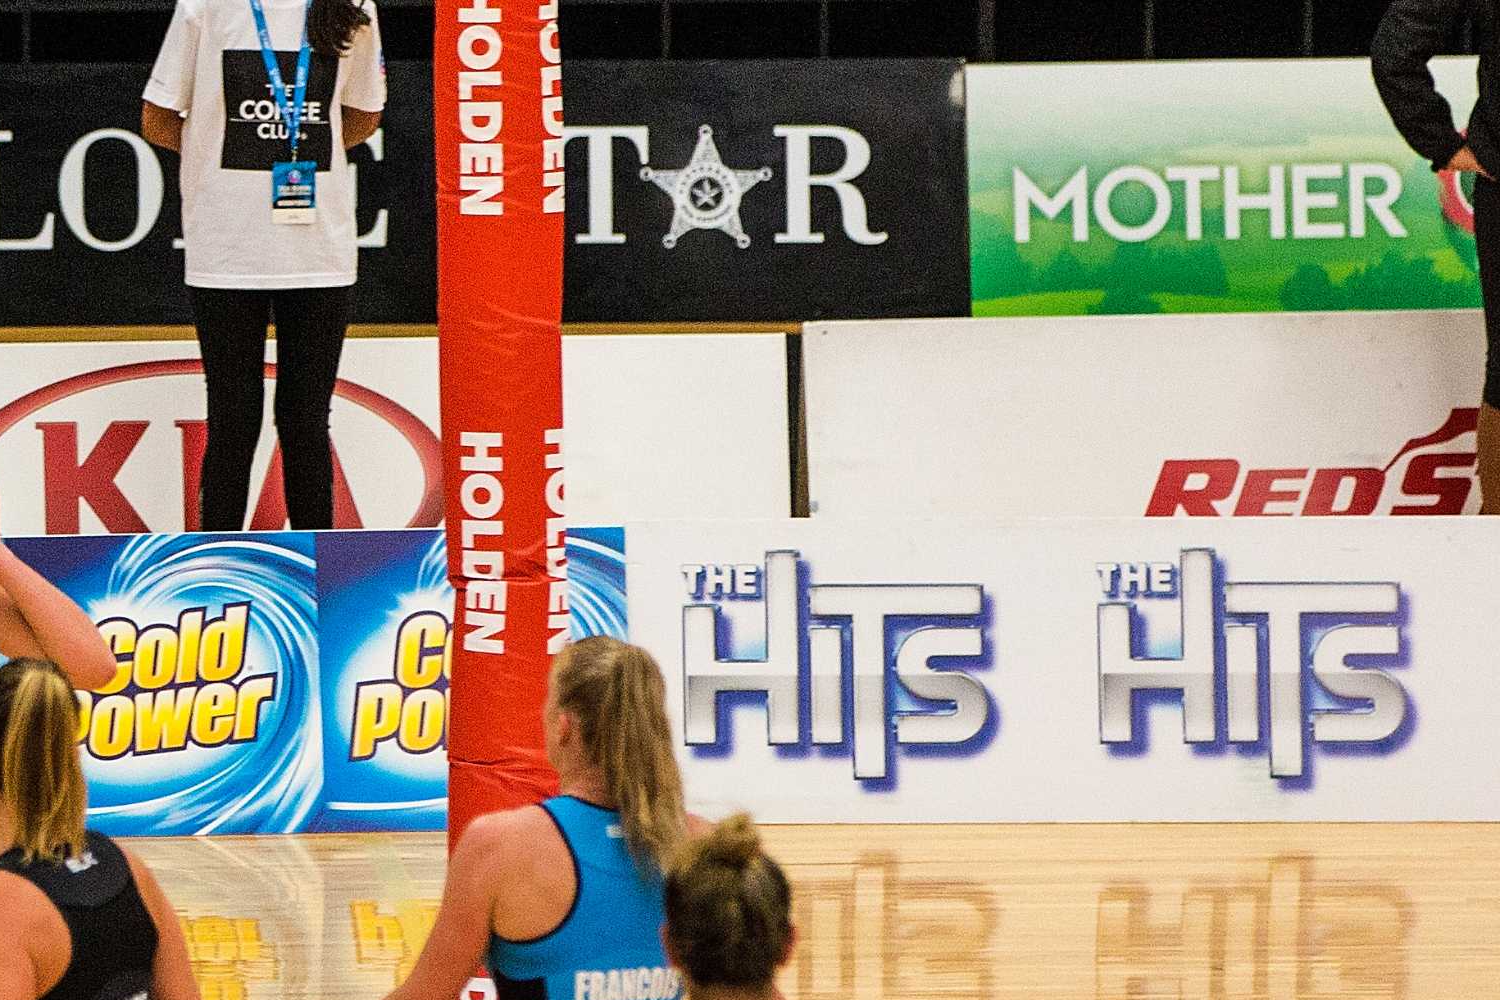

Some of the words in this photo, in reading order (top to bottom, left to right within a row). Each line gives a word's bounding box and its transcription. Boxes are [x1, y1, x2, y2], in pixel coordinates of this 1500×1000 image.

[265, 84, 296, 97] TE
[256, 123, 302, 140] CLU
[1012, 163, 1408, 243] MOTHER
[459, 431, 509, 655] HOLDEN
[682, 563, 762, 597] THE
[1097, 561, 1178, 596] THE
